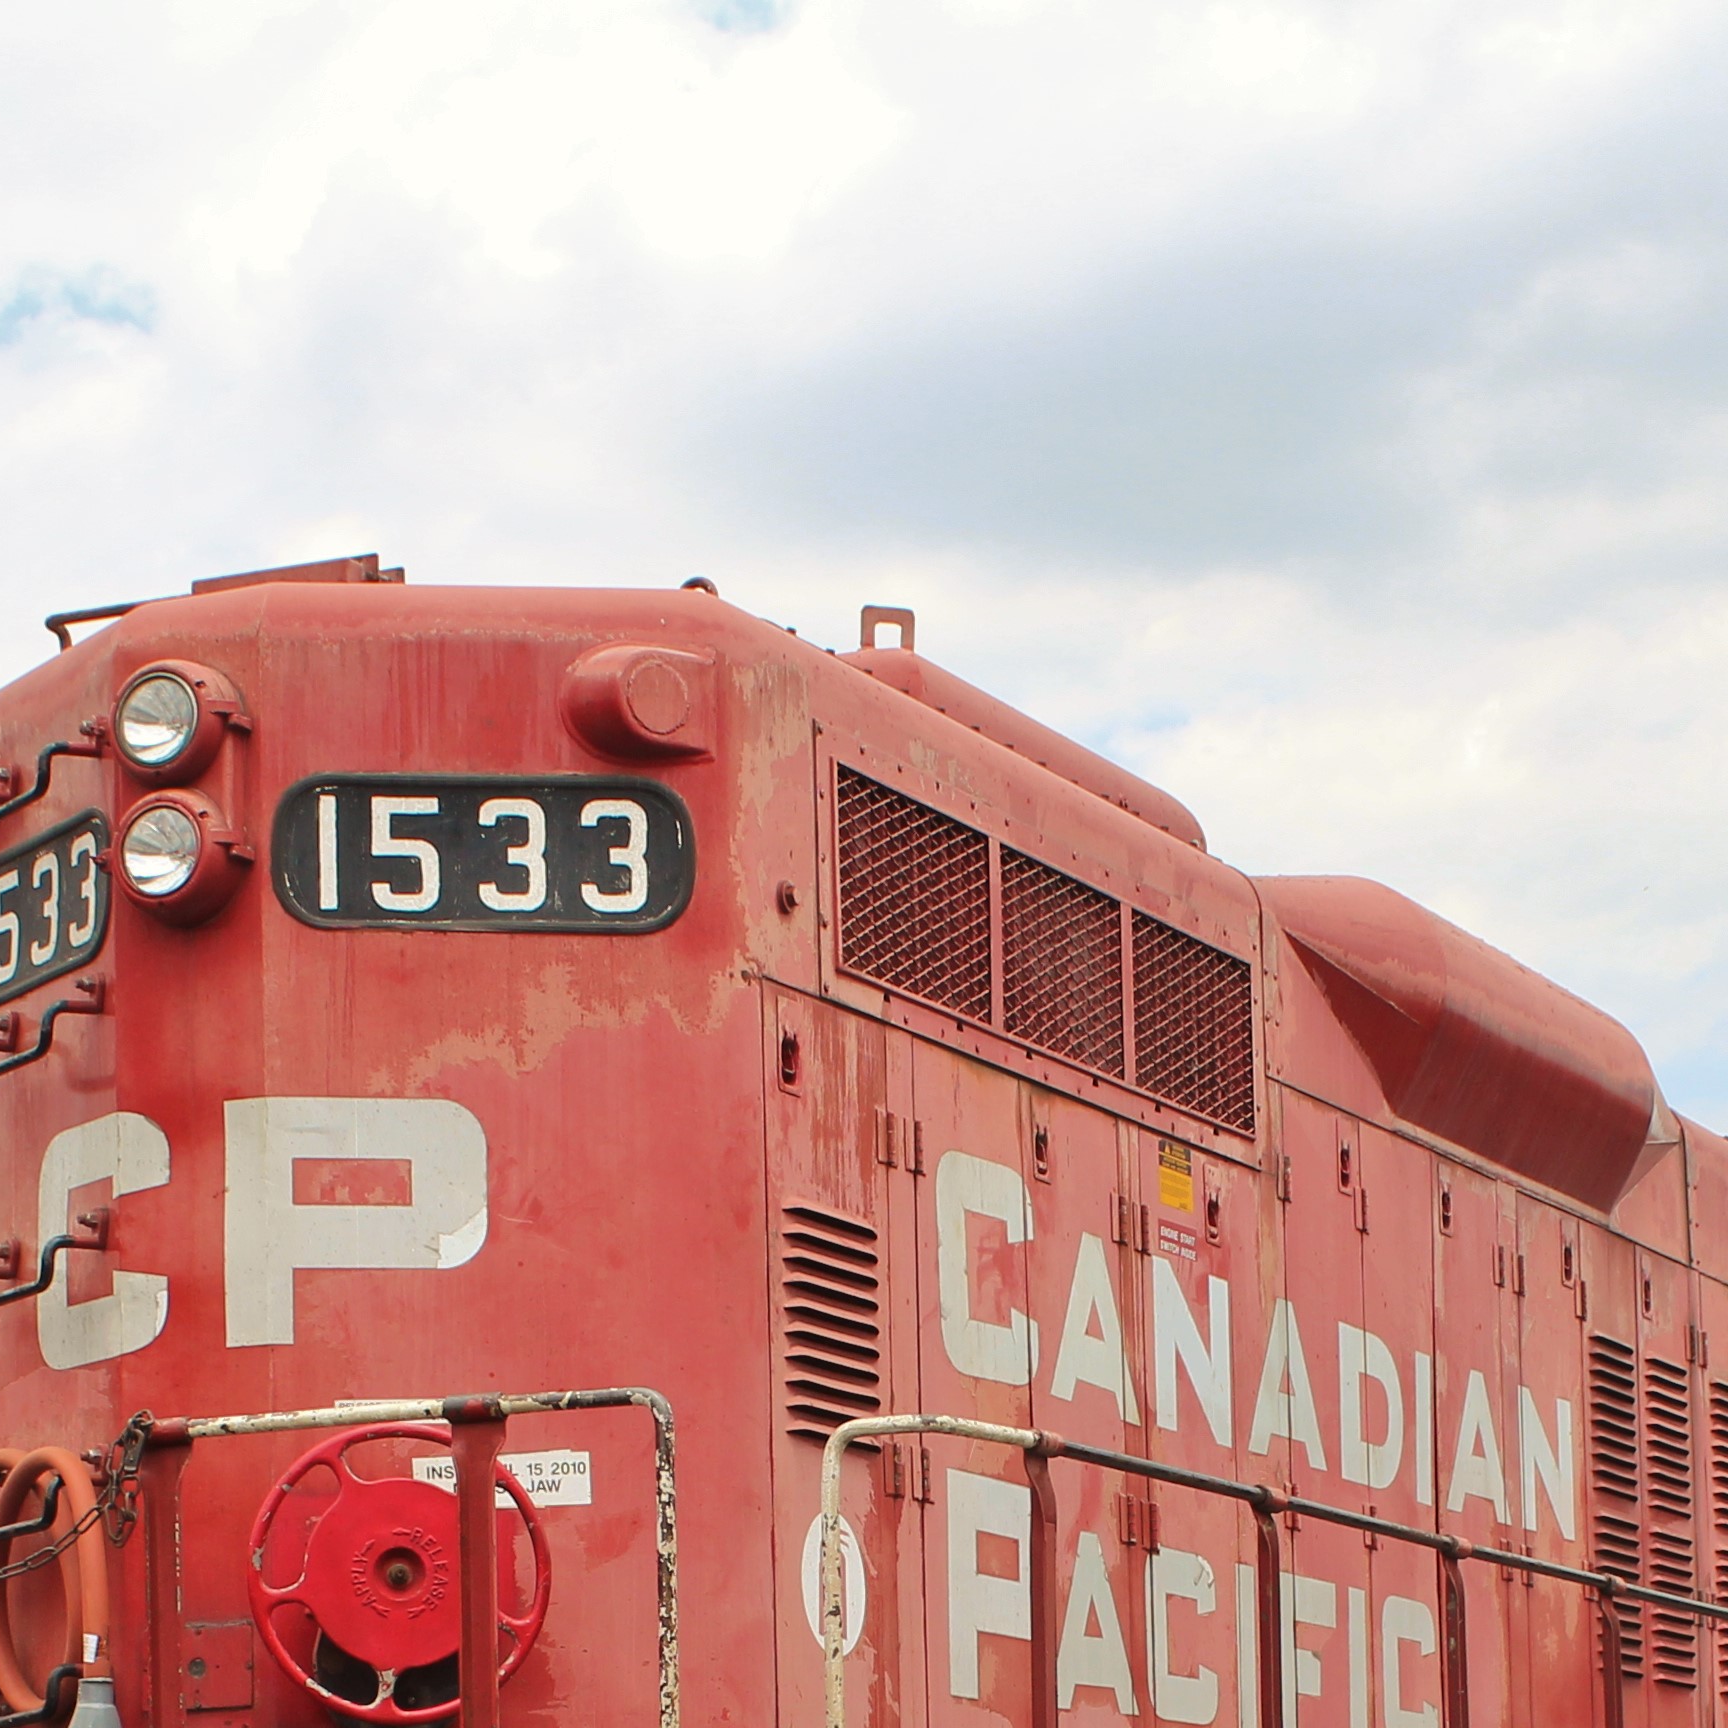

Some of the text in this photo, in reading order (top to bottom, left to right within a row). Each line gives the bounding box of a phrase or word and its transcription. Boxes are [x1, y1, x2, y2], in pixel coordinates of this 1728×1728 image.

[316, 795, 649, 914] 1533
[38, 1097, 489, 1371] CP
[934, 1149, 1577, 1542] CANADIAN
[526, 1463, 543, 1476] 15
[550, 1461, 587, 1476] 2010
[526, 1479, 562, 1494] JAW
[351, 1550, 377, 1607] APPLY
[410, 1526, 449, 1611] RELEASE
